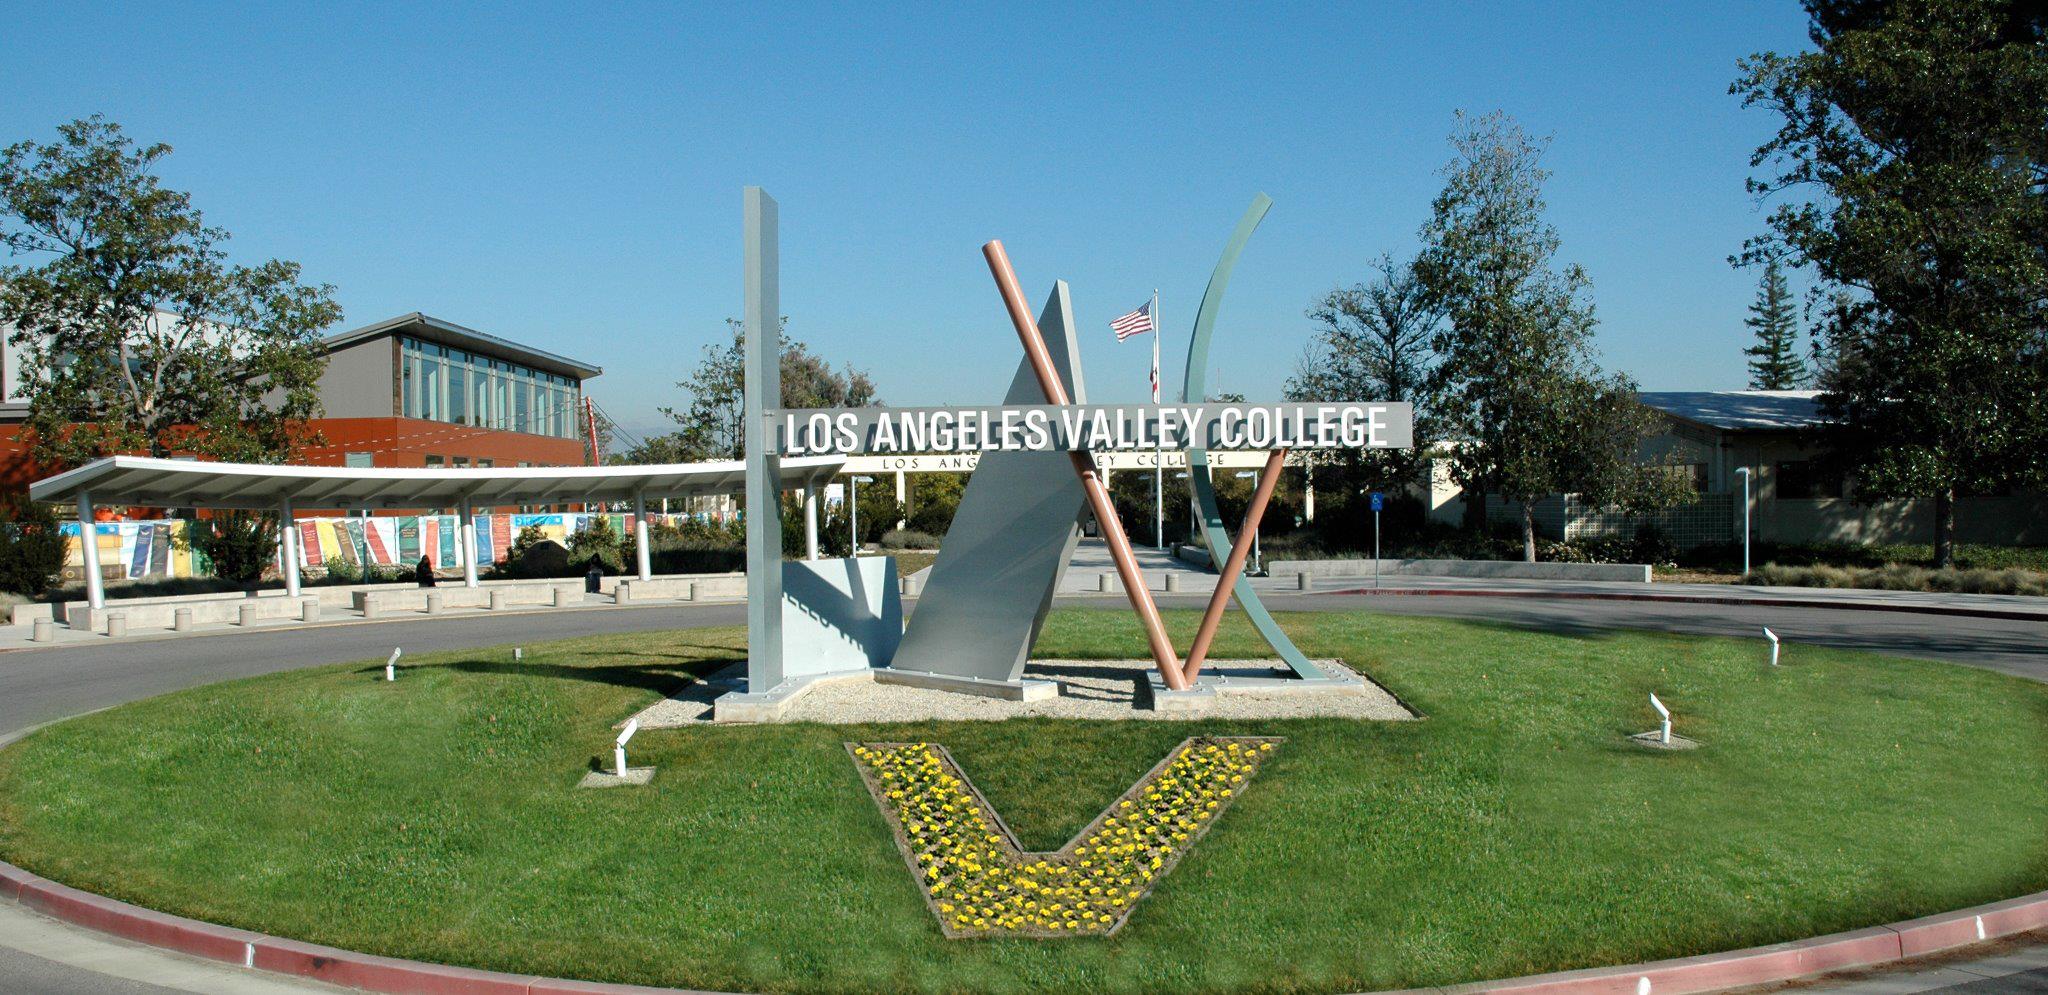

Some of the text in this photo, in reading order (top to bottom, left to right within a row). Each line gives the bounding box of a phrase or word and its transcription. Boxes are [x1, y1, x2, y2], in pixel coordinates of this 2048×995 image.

[787, 406, 1388, 453] LOS ANGELES VALLEY COLLEGE
[883, 458, 919, 469] LOS
